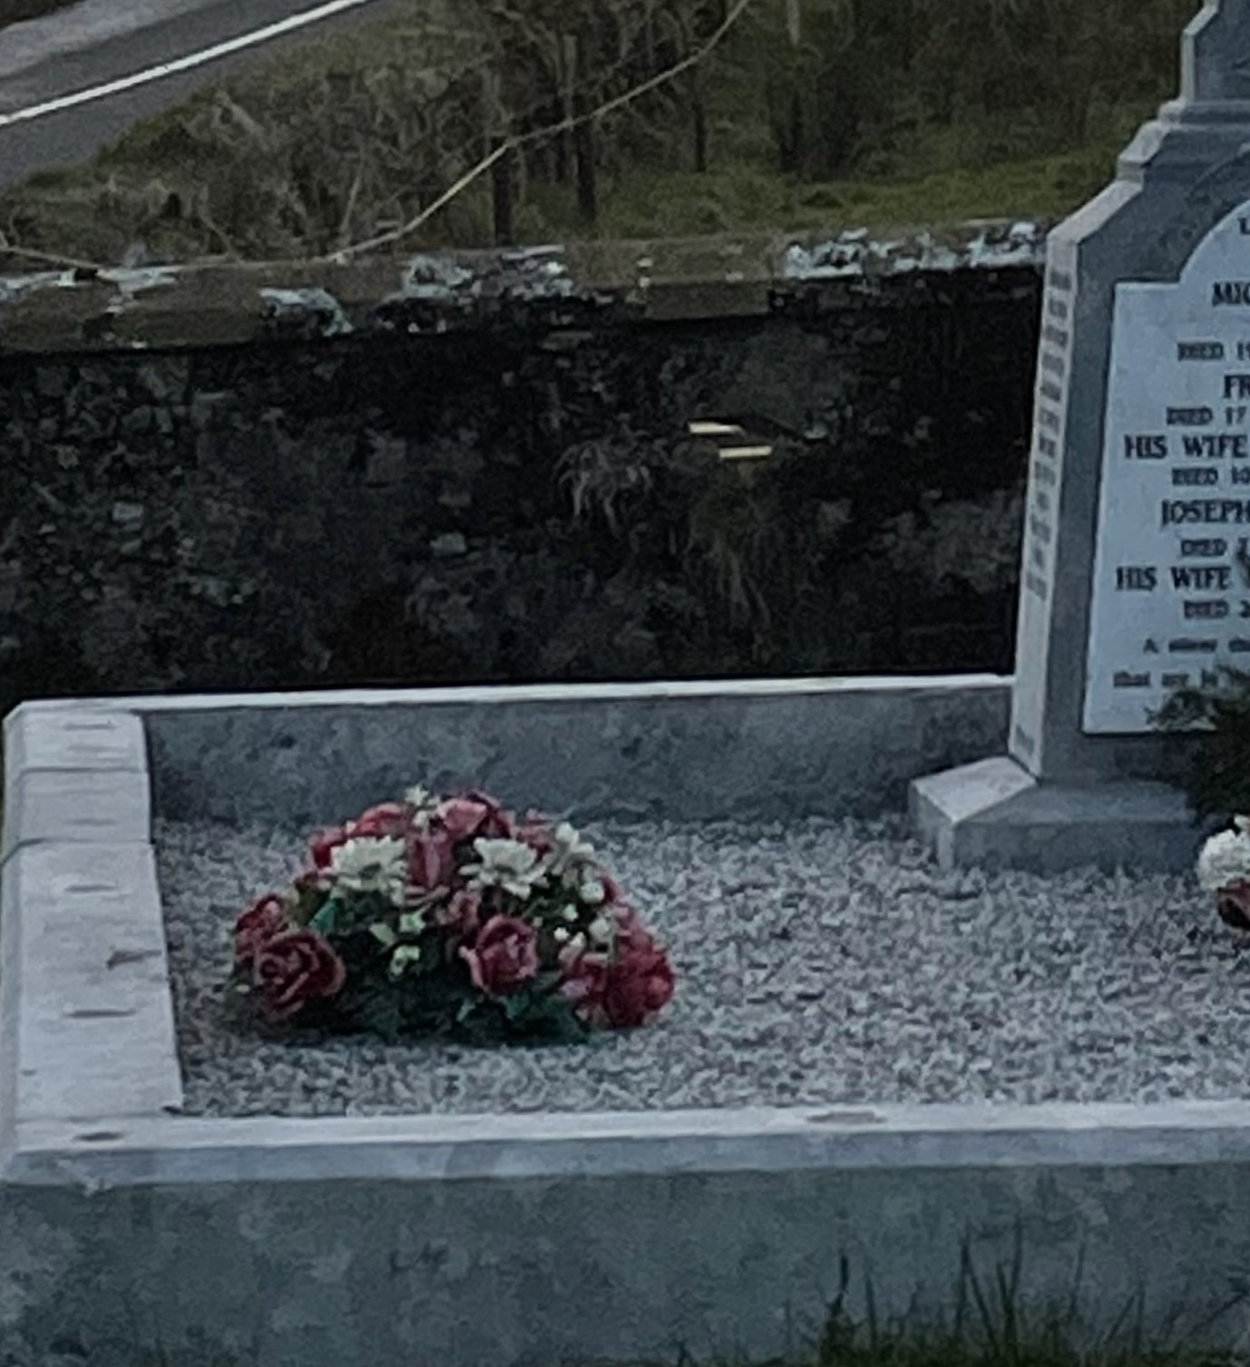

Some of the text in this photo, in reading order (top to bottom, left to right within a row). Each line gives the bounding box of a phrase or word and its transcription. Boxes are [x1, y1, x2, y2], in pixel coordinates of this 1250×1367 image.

[1177, 342, 1225, 361] DIED
[1166, 407, 1213, 426] DIED
[1124, 435, 1168, 459] HIS
[1182, 434, 1248, 458] WIFE
[1172, 467, 1218, 486] DIED
[1180, 538, 1227, 557] DIED
[1116, 566, 1157, 591] HIS
[1170, 566, 1230, 589] WIFE
[1184, 600, 1230, 619] DIED
